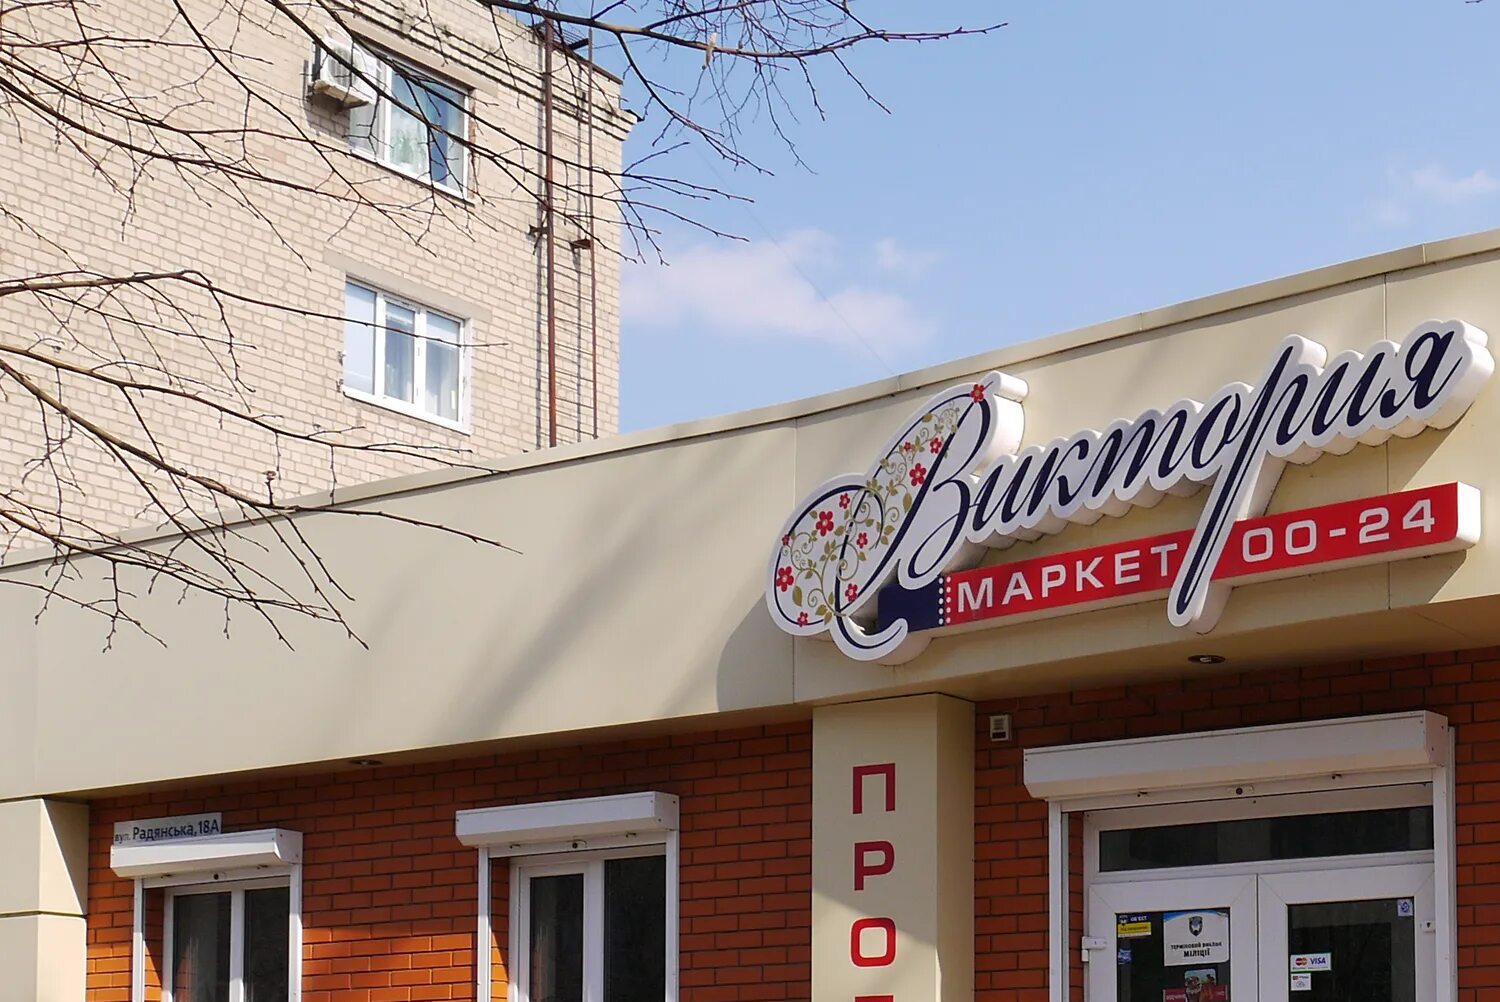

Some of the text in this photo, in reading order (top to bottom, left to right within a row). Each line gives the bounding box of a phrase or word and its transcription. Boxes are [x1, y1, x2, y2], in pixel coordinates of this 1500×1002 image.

[771, 330, 1466, 650] Виктория
[957, 498, 1437, 613] МАРКЕТ 00-24
[1183, 948, 1211, 958] МІЛІЦІЇ
[1310, 957, 1326, 965] VISA
